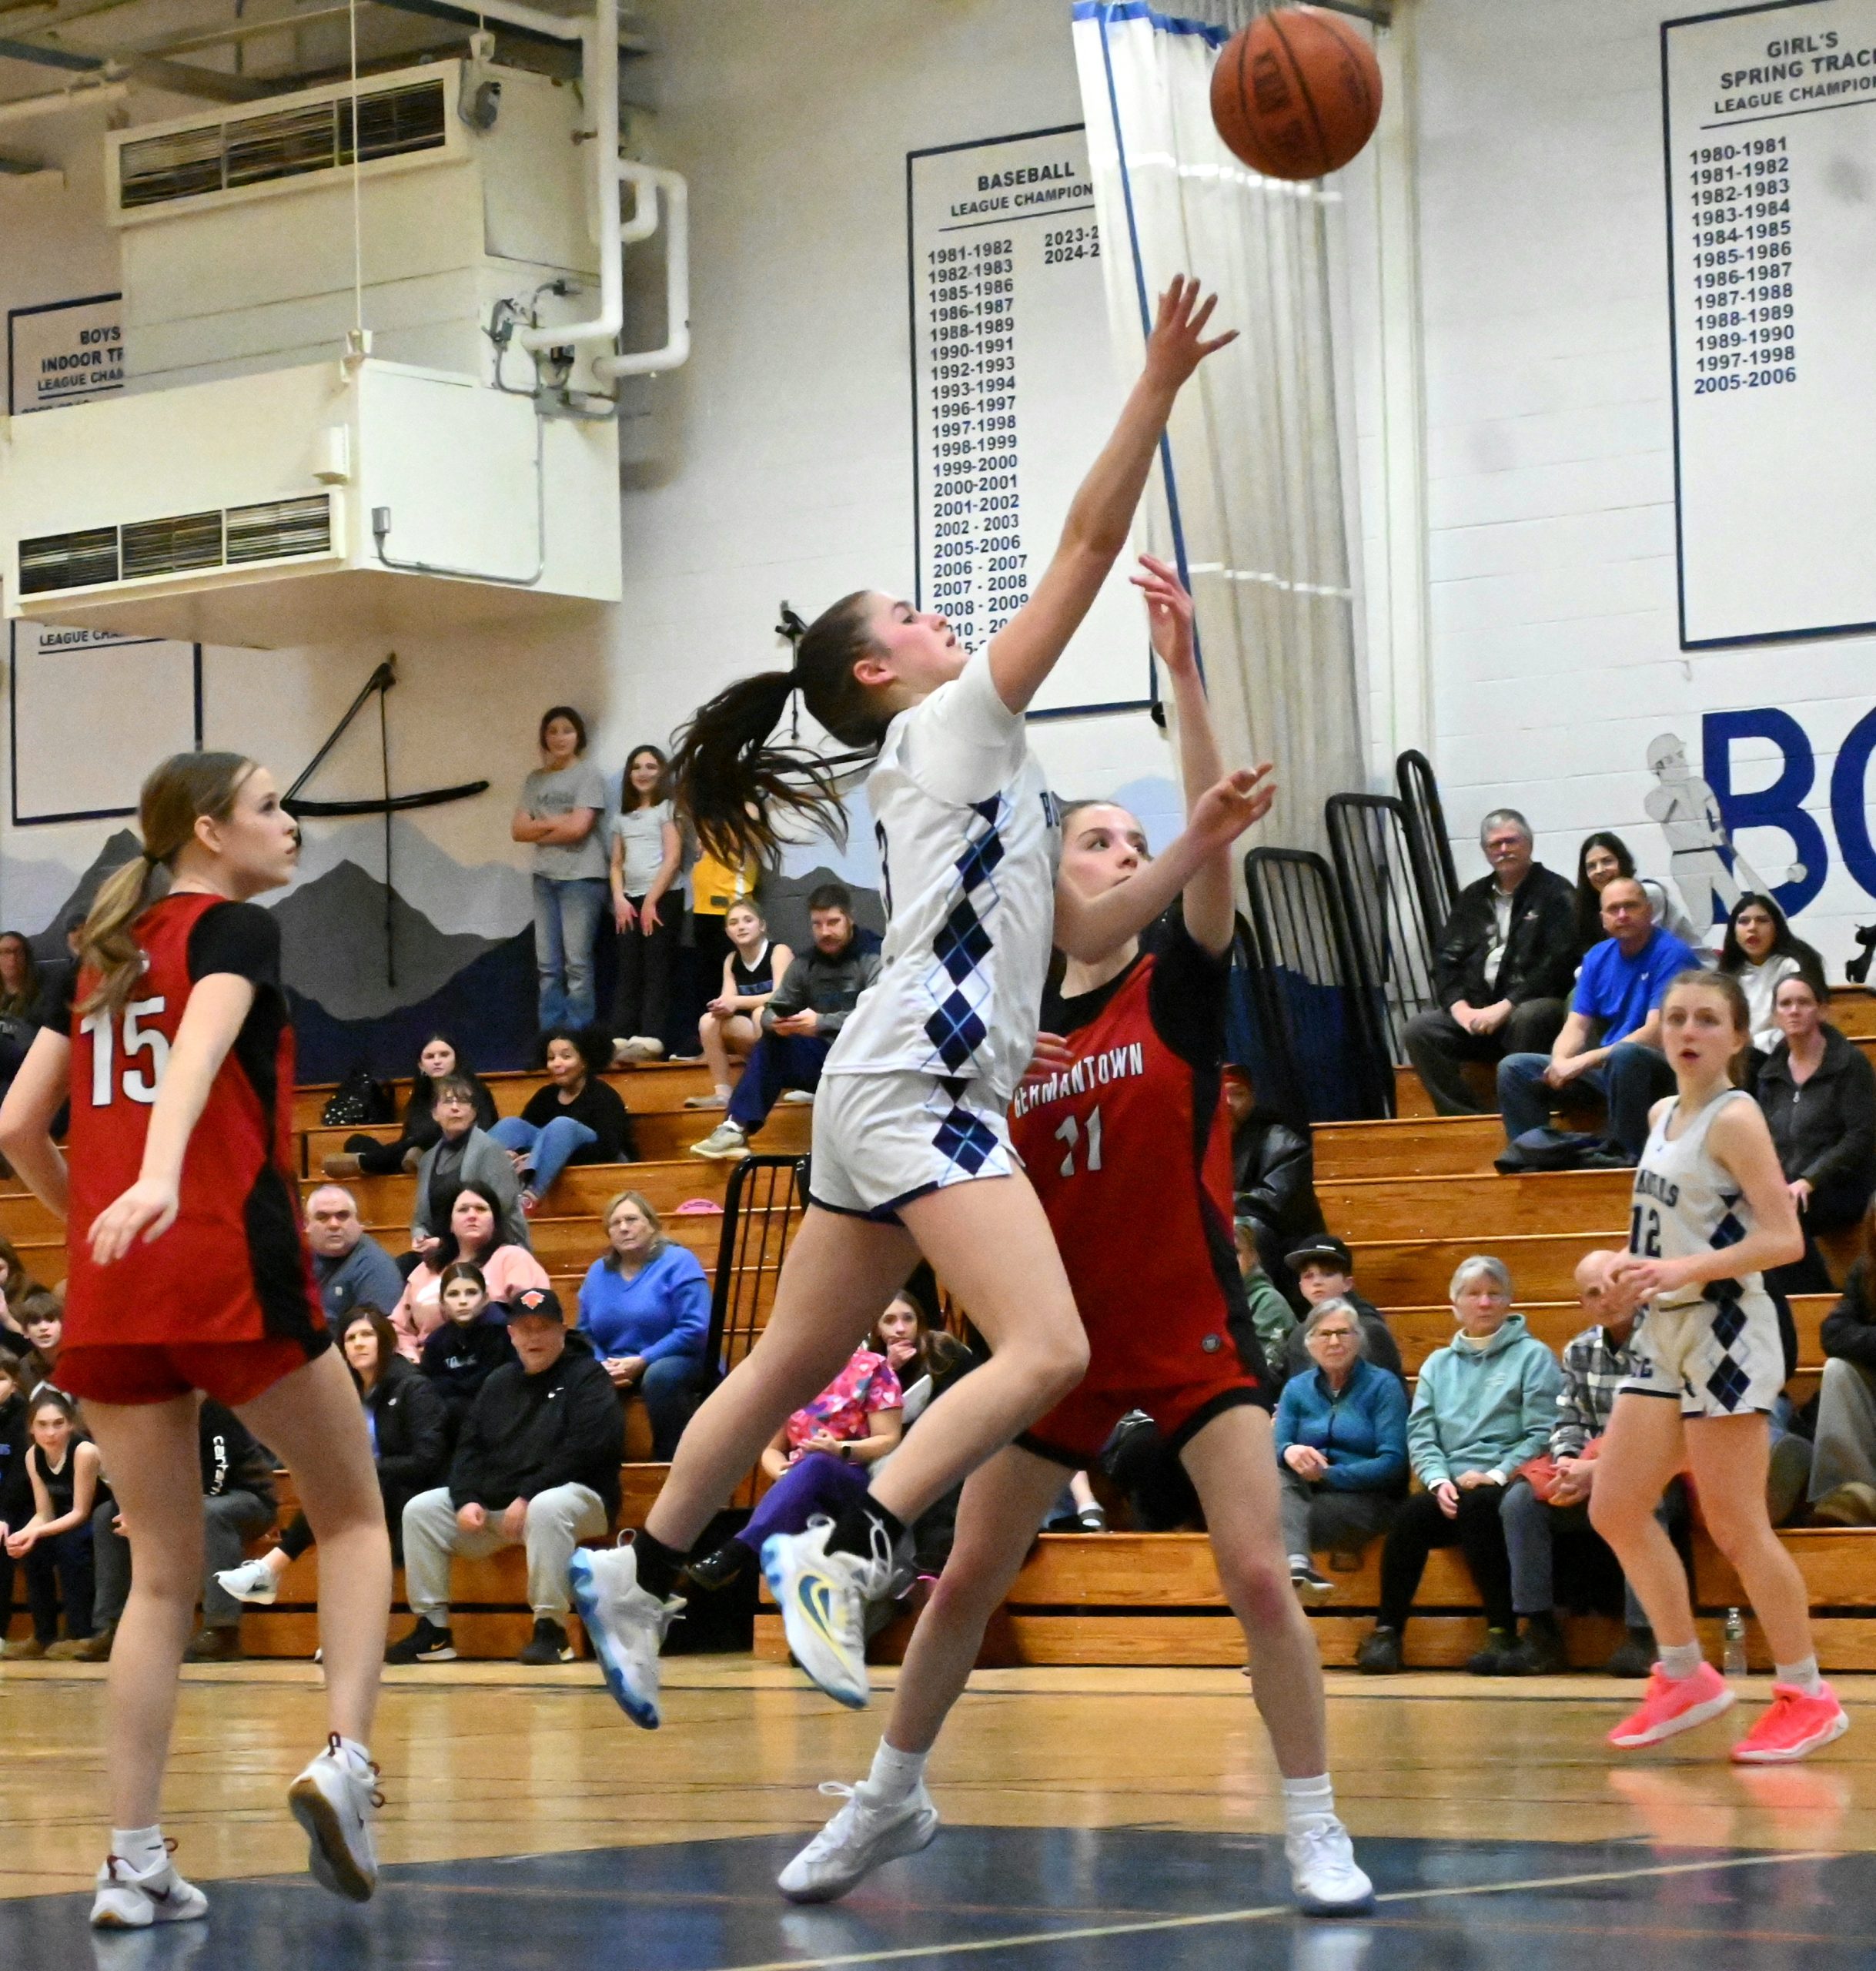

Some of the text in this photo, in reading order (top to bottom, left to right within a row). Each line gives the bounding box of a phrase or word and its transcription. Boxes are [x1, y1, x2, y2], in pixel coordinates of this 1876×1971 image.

[1767, 32, 1838, 58] GIRL'S
[1721, 49, 1876, 89] SPRING TRAC
[1715, 91, 1784, 114] LEAGUE
[1690, 136, 1787, 165] 1980-1981
[978, 162, 1075, 191] BASEBALL
[1690, 157, 1789, 186] 1981-1982
[1691, 178, 1790, 206] 1982-1983
[951, 196, 1009, 217] LEAGUE
[1692, 199, 1791, 227] 1983-1984
[1693, 220, 1791, 247] 1984-1985
[928, 239, 1012, 265] 1981-1982
[1694, 241, 1791, 269] 1985-1986
[928, 259, 1012, 284] 1982-1983
[1694, 262, 1792, 289] 1986-1987
[929, 279, 1013, 303] 1985-1986
[1694, 283, 1793, 310] 1987-1988
[929, 298, 1014, 323] 1986-1987
[1695, 303, 1794, 331] 1988-1989
[80, 326, 121, 345] BOYS
[930, 317, 1014, 342] 1988-1989
[1696, 324, 1794, 352] 1989-1990
[931, 337, 1014, 361] 1990-1991
[1697, 346, 1795, 373] 1997-1998
[42, 351, 102, 373] INDOOR
[931, 357, 1015, 380] 1992-1993
[38, 374, 86, 391] LEAGUE
[931, 376, 1015, 400] 1993-1994
[1694, 366, 1796, 394] 2005-2006
[932, 396, 1015, 420] 1996-1997
[933, 415, 1016, 438] 1997-1998
[933, 434, 1017, 458] 1998-1999
[934, 454, 1018, 477] 1999-2000
[934, 474, 1018, 497] 2000-2001
[934, 494, 1019, 517] 2001-2002
[935, 520, 969, 537] 2002
[984, 514, 1020, 532] 2003
[934, 534, 1021, 557] 2005-2006
[933, 561, 972, 578] 2006
[988, 554, 1028, 572] 2007
[933, 581, 971, 597] 2007
[988, 574, 1028, 591] 2008
[934, 600, 975, 617] 2008
[40, 631, 88, 646] LEAGUE
[81, 996, 170, 1106] 15
[1055, 1104, 1102, 1177] 11
[1629, 1204, 1661, 1258] 12
